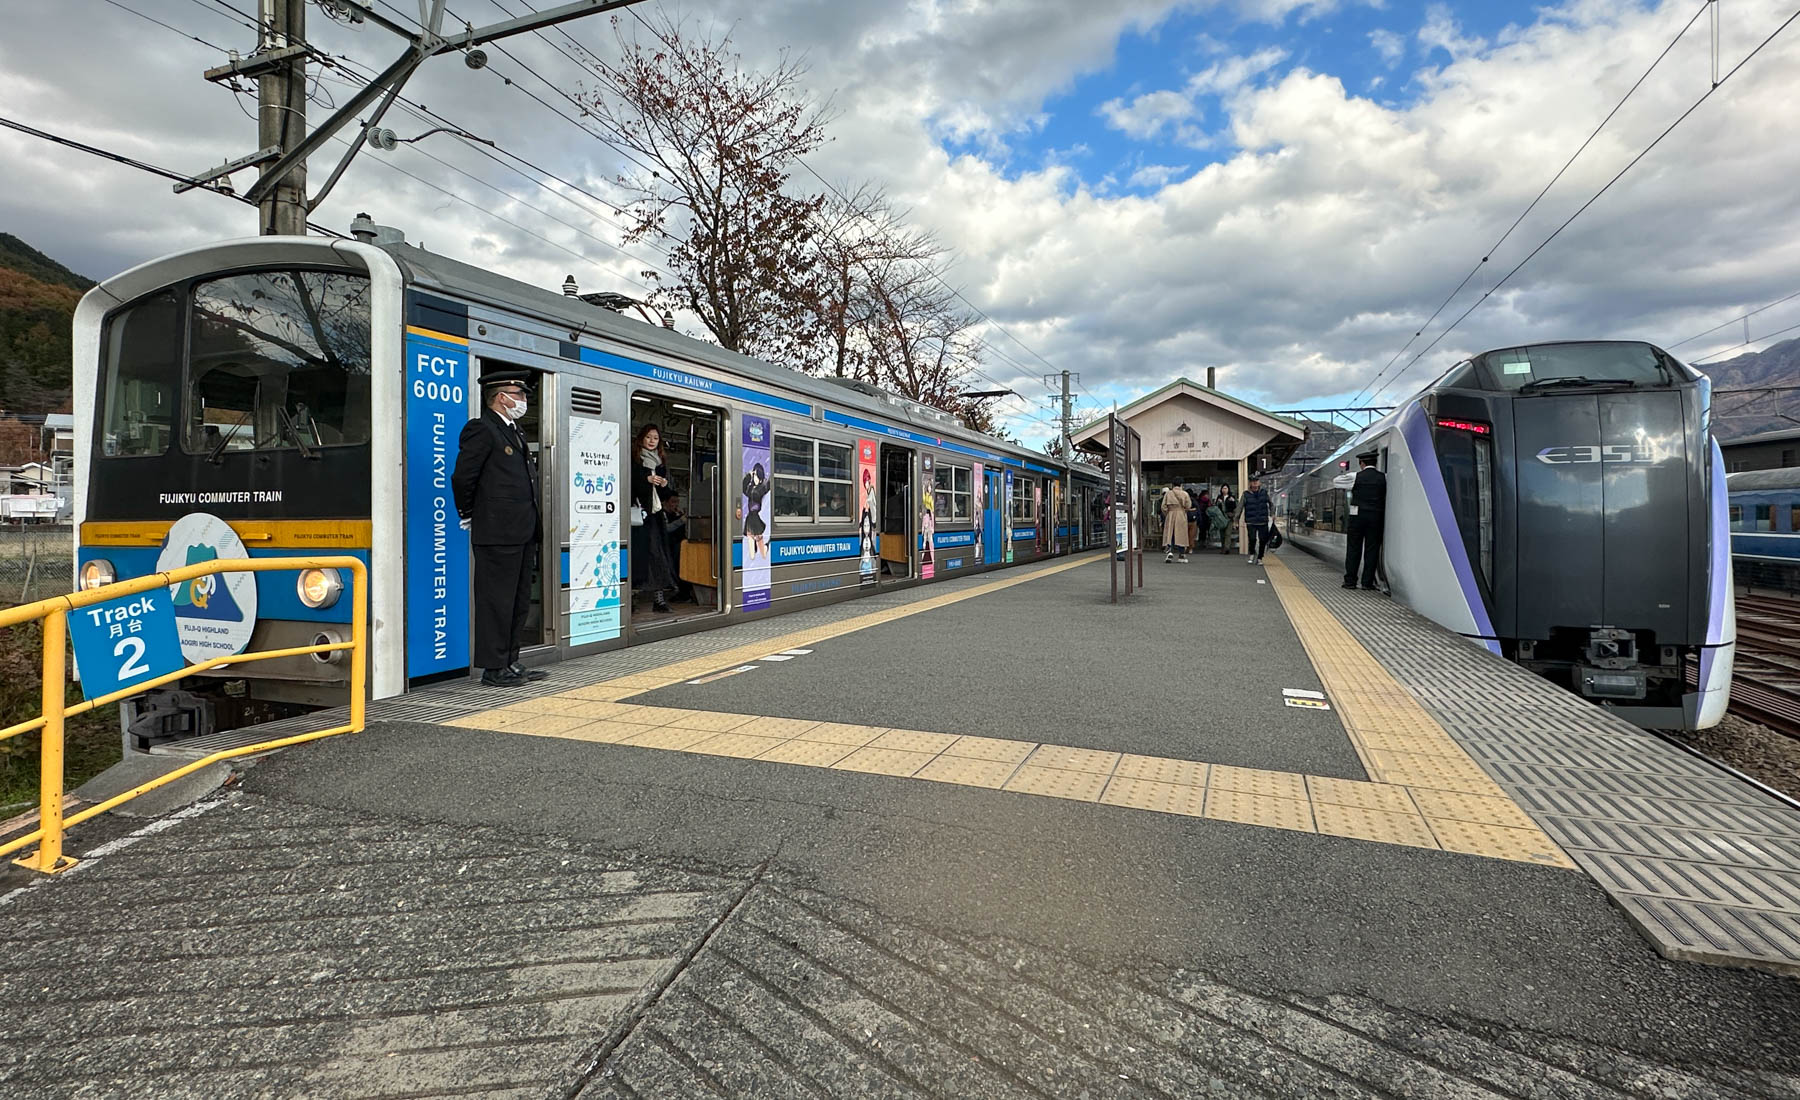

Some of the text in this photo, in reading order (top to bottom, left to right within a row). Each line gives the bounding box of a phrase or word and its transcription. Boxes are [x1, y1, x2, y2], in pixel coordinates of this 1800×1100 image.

[417, 354, 458, 378] FCT
[652, 368, 713, 389] FUJIKYU RAILWAY
[413, 380, 463, 404] 6000
[1261, 458, 1267, 469] 1
[159, 490, 282, 504] FUJIKYU COMMUTER TRAIN
[433, 413, 447, 660] FUJIKYU COMMUTER TRAIN
[780, 542, 851, 557] FUJIKYU COMMUTER TRAIN
[87, 597, 156, 627] Track
[109, 619, 143, 639] 月台
[202, 626, 229, 634] HIGHLAND
[213, 642, 234, 650] SCHOOL
[113, 636, 150, 681] 2
